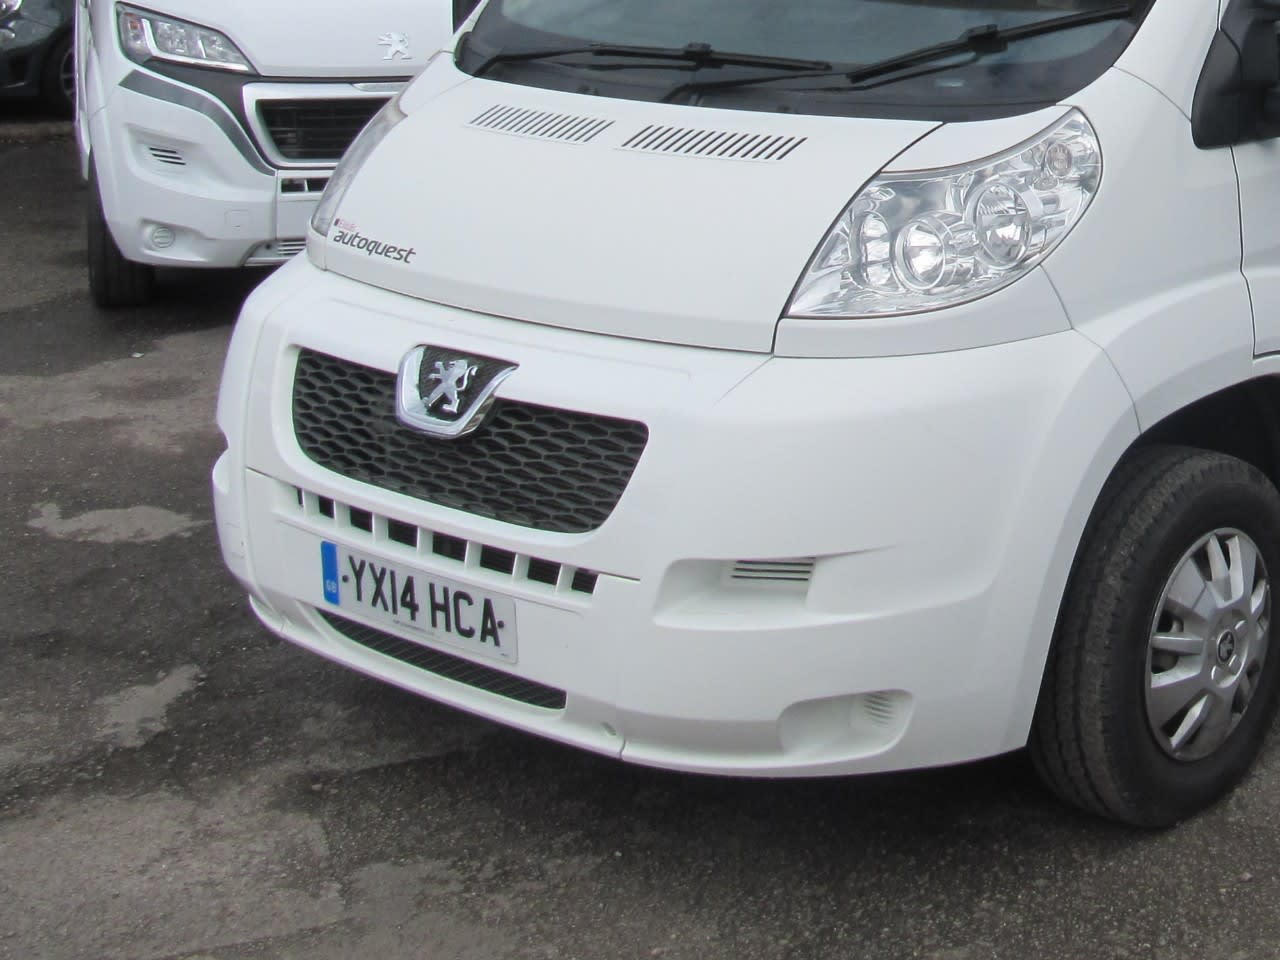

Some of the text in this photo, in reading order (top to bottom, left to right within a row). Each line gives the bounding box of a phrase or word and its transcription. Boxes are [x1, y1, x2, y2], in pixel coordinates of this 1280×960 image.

[333, 230, 417, 264] autoquest
[348, 555, 501, 647] YX14 HCA
